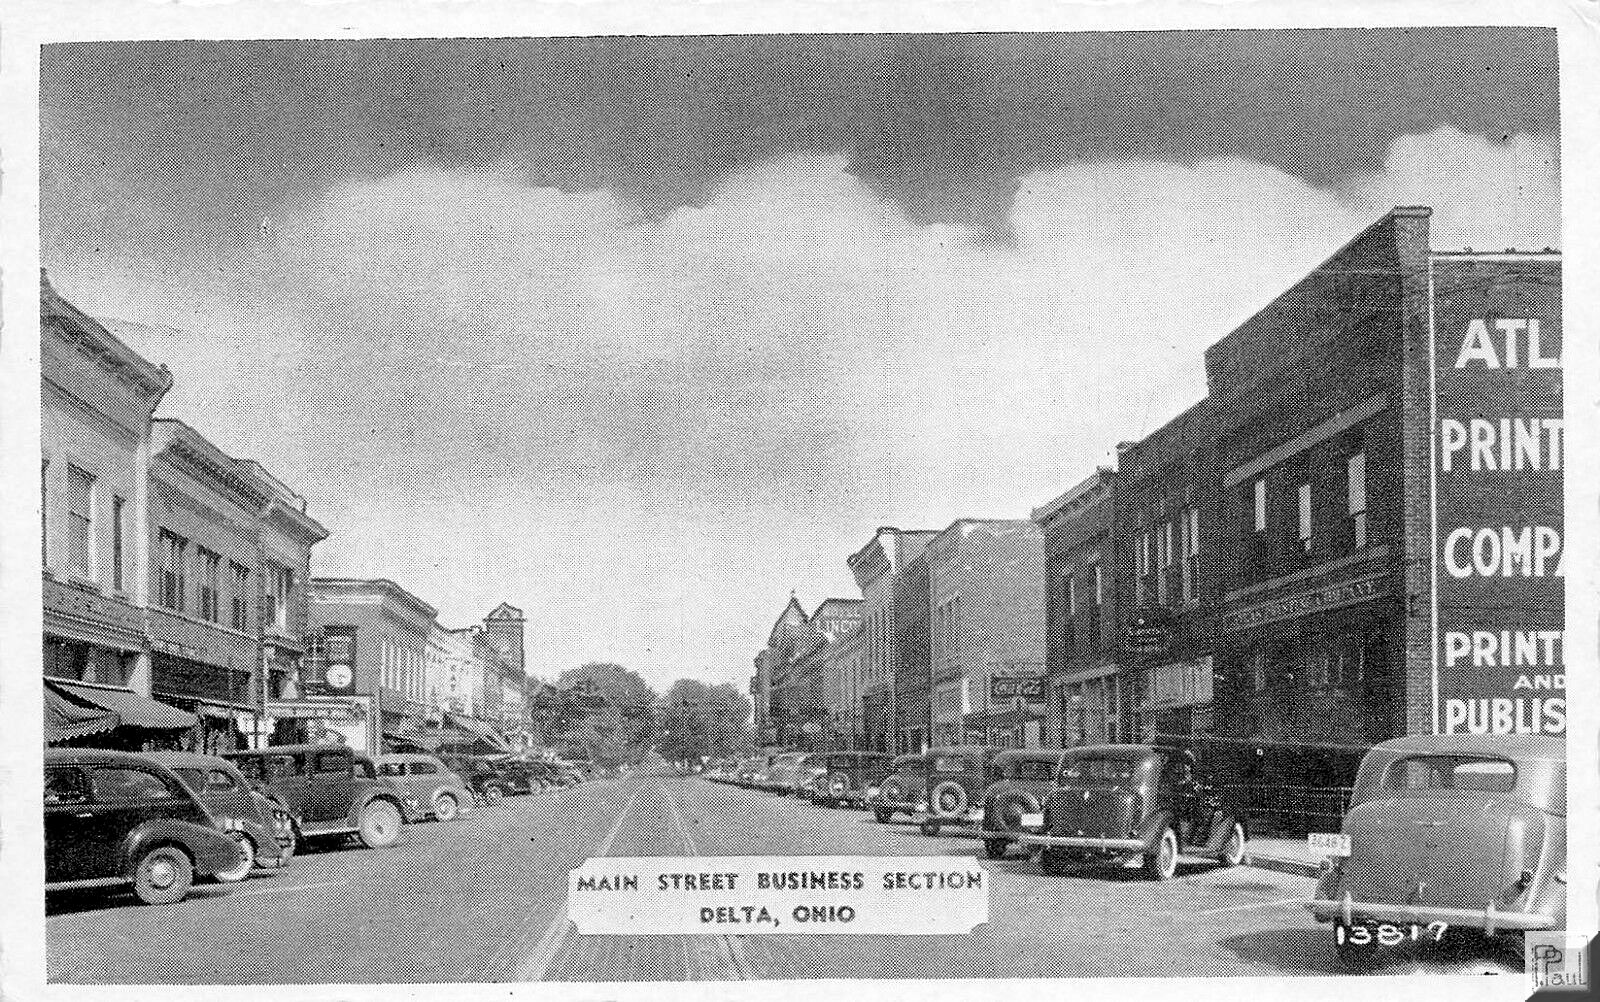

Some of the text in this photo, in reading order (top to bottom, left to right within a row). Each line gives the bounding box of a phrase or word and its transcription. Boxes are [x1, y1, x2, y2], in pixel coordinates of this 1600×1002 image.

[1455, 319, 1563, 368] ATL
[1446, 630, 1565, 667] PRINT
[1514, 675, 1566, 690] AND
[1446, 698, 1566, 734] PUBLIS
